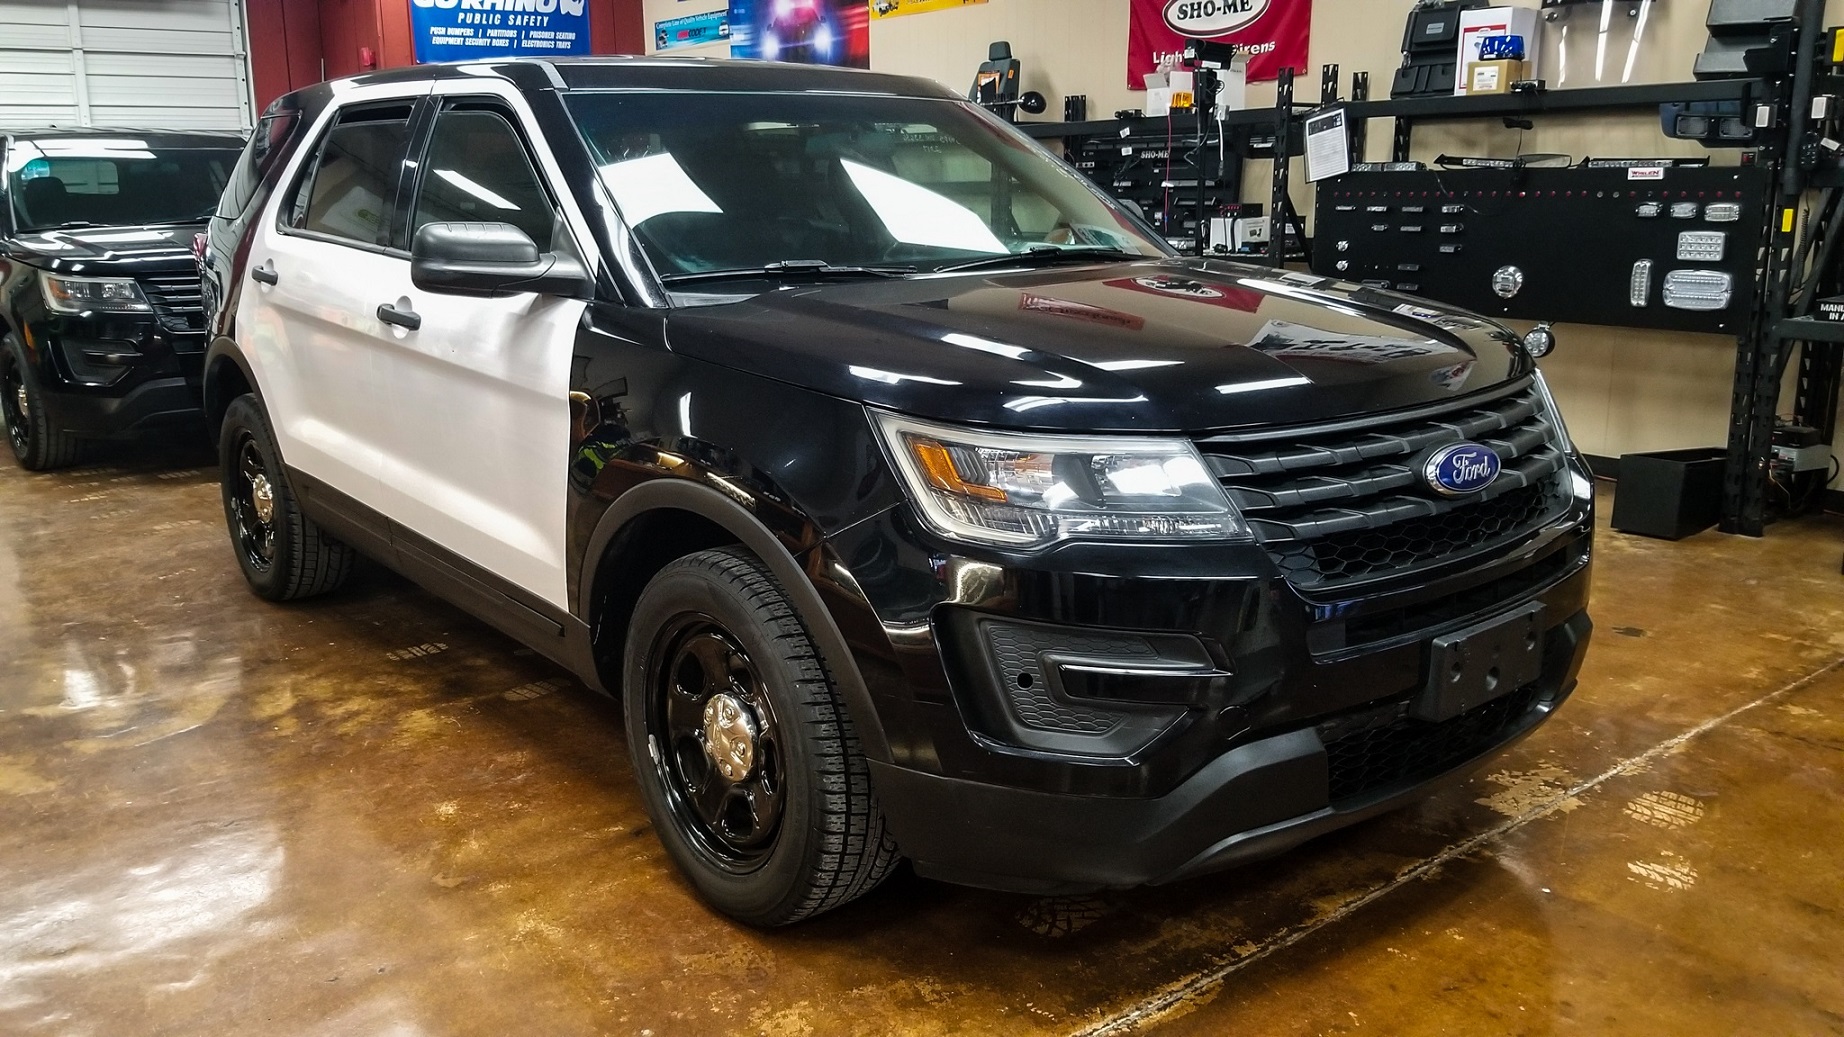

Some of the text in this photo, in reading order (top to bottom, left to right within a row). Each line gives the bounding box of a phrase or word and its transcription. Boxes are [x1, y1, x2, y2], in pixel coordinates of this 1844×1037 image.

[708, 10, 728, 20] Equipment
[1177, 0, 1253, 20] SHO-ME
[458, 12, 549, 27] PUBLIC SAFETY
[430, 26, 576, 40] PUSH BUMPERS PARTITIONS PRISONER SEATING
[432, 36, 571, 49] EQUIPMENT SECURITY BOXES ELECTRONICS TRAYS
[1153, 50, 1186, 66] Ligh
[1140, 150, 1170, 159] SHO-ME
[1829, 312, 1839, 321] IN
[1453, 451, 1491, 485] Ford
